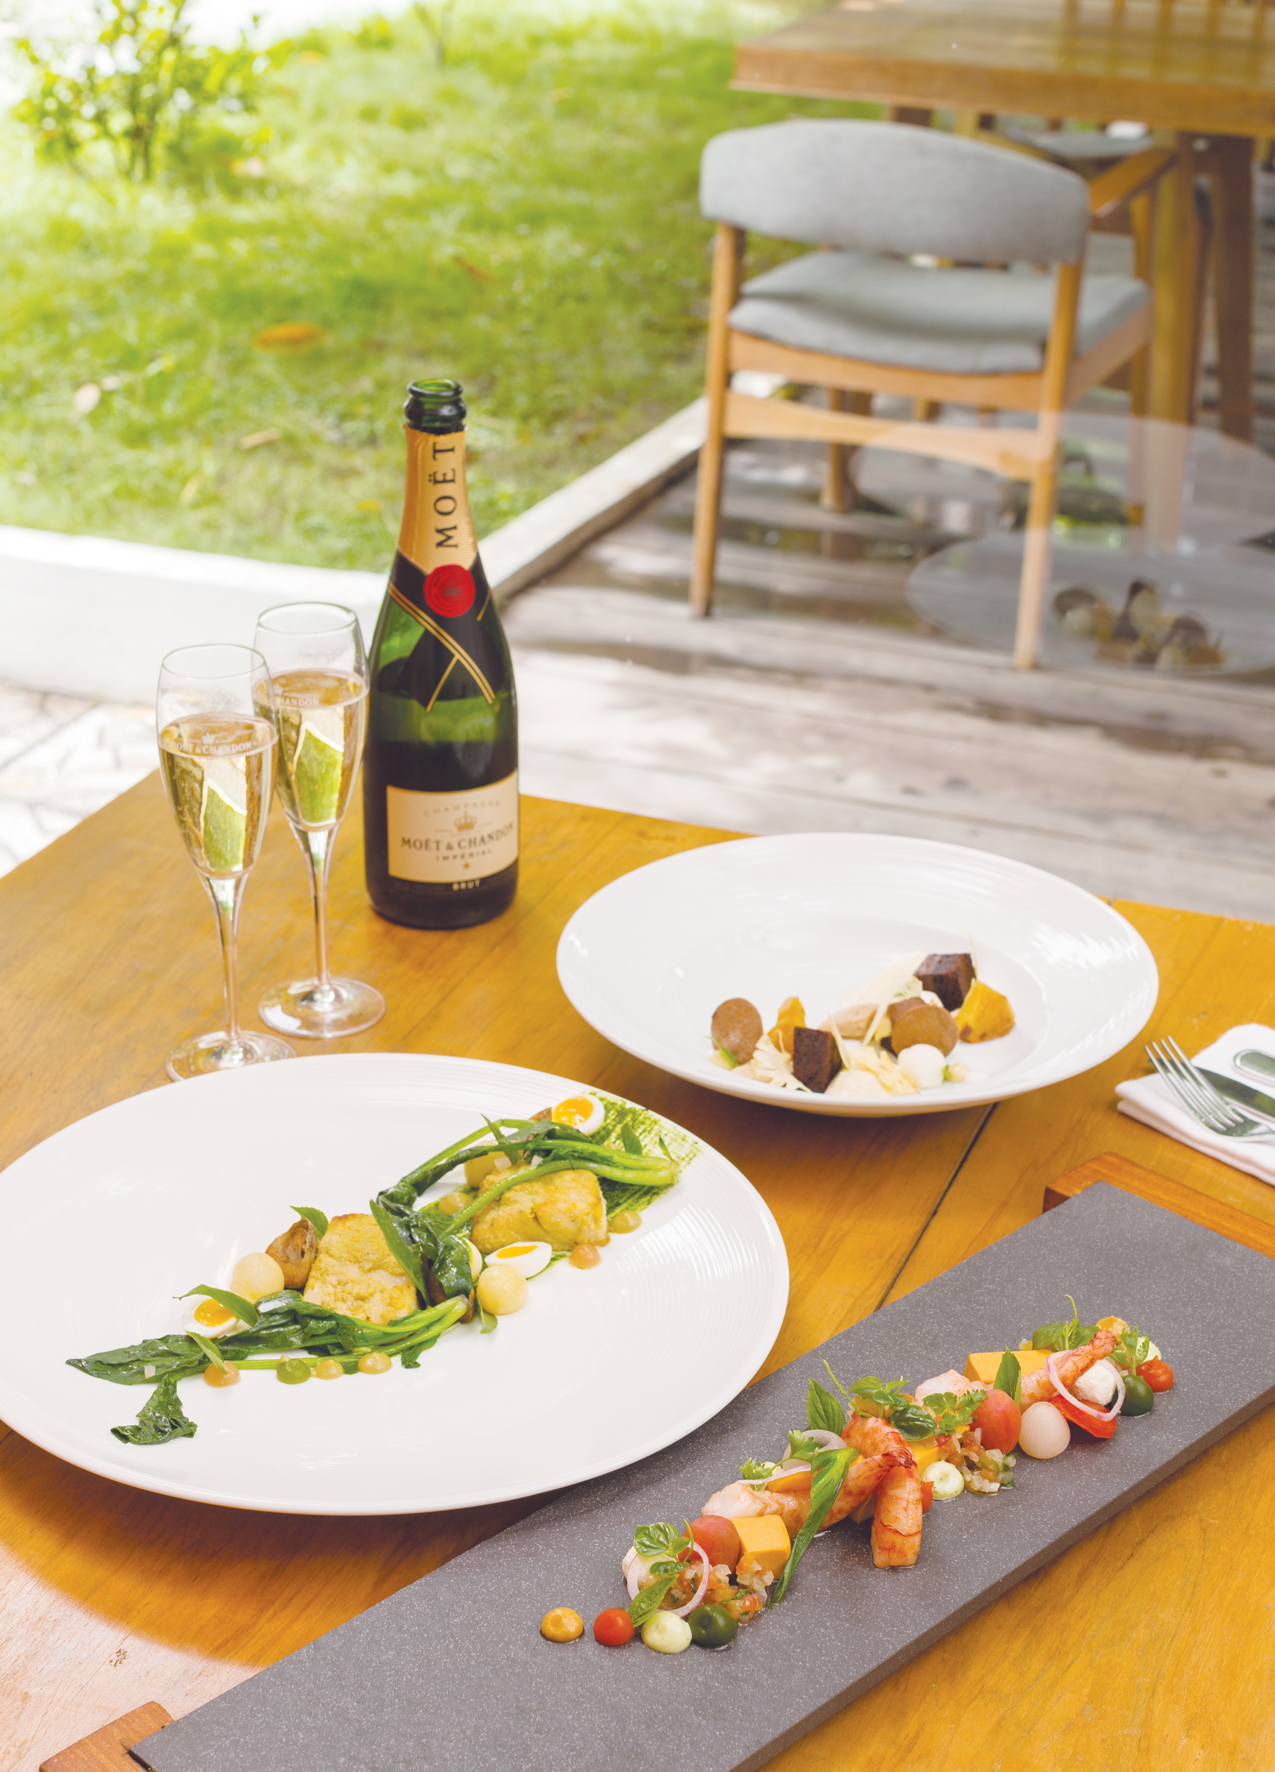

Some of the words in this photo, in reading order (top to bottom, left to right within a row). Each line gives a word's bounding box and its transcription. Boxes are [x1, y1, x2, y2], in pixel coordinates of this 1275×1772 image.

[429, 442, 459, 548] MOËT
[202, 741, 252, 754] CHANDON
[423, 801, 501, 817] CHAMPAGNE
[400, 836, 445, 851] MOËT
[446, 841, 454, 851] &
[457, 820, 515, 850] CHANDON
[452, 879, 481, 891] BRUT
